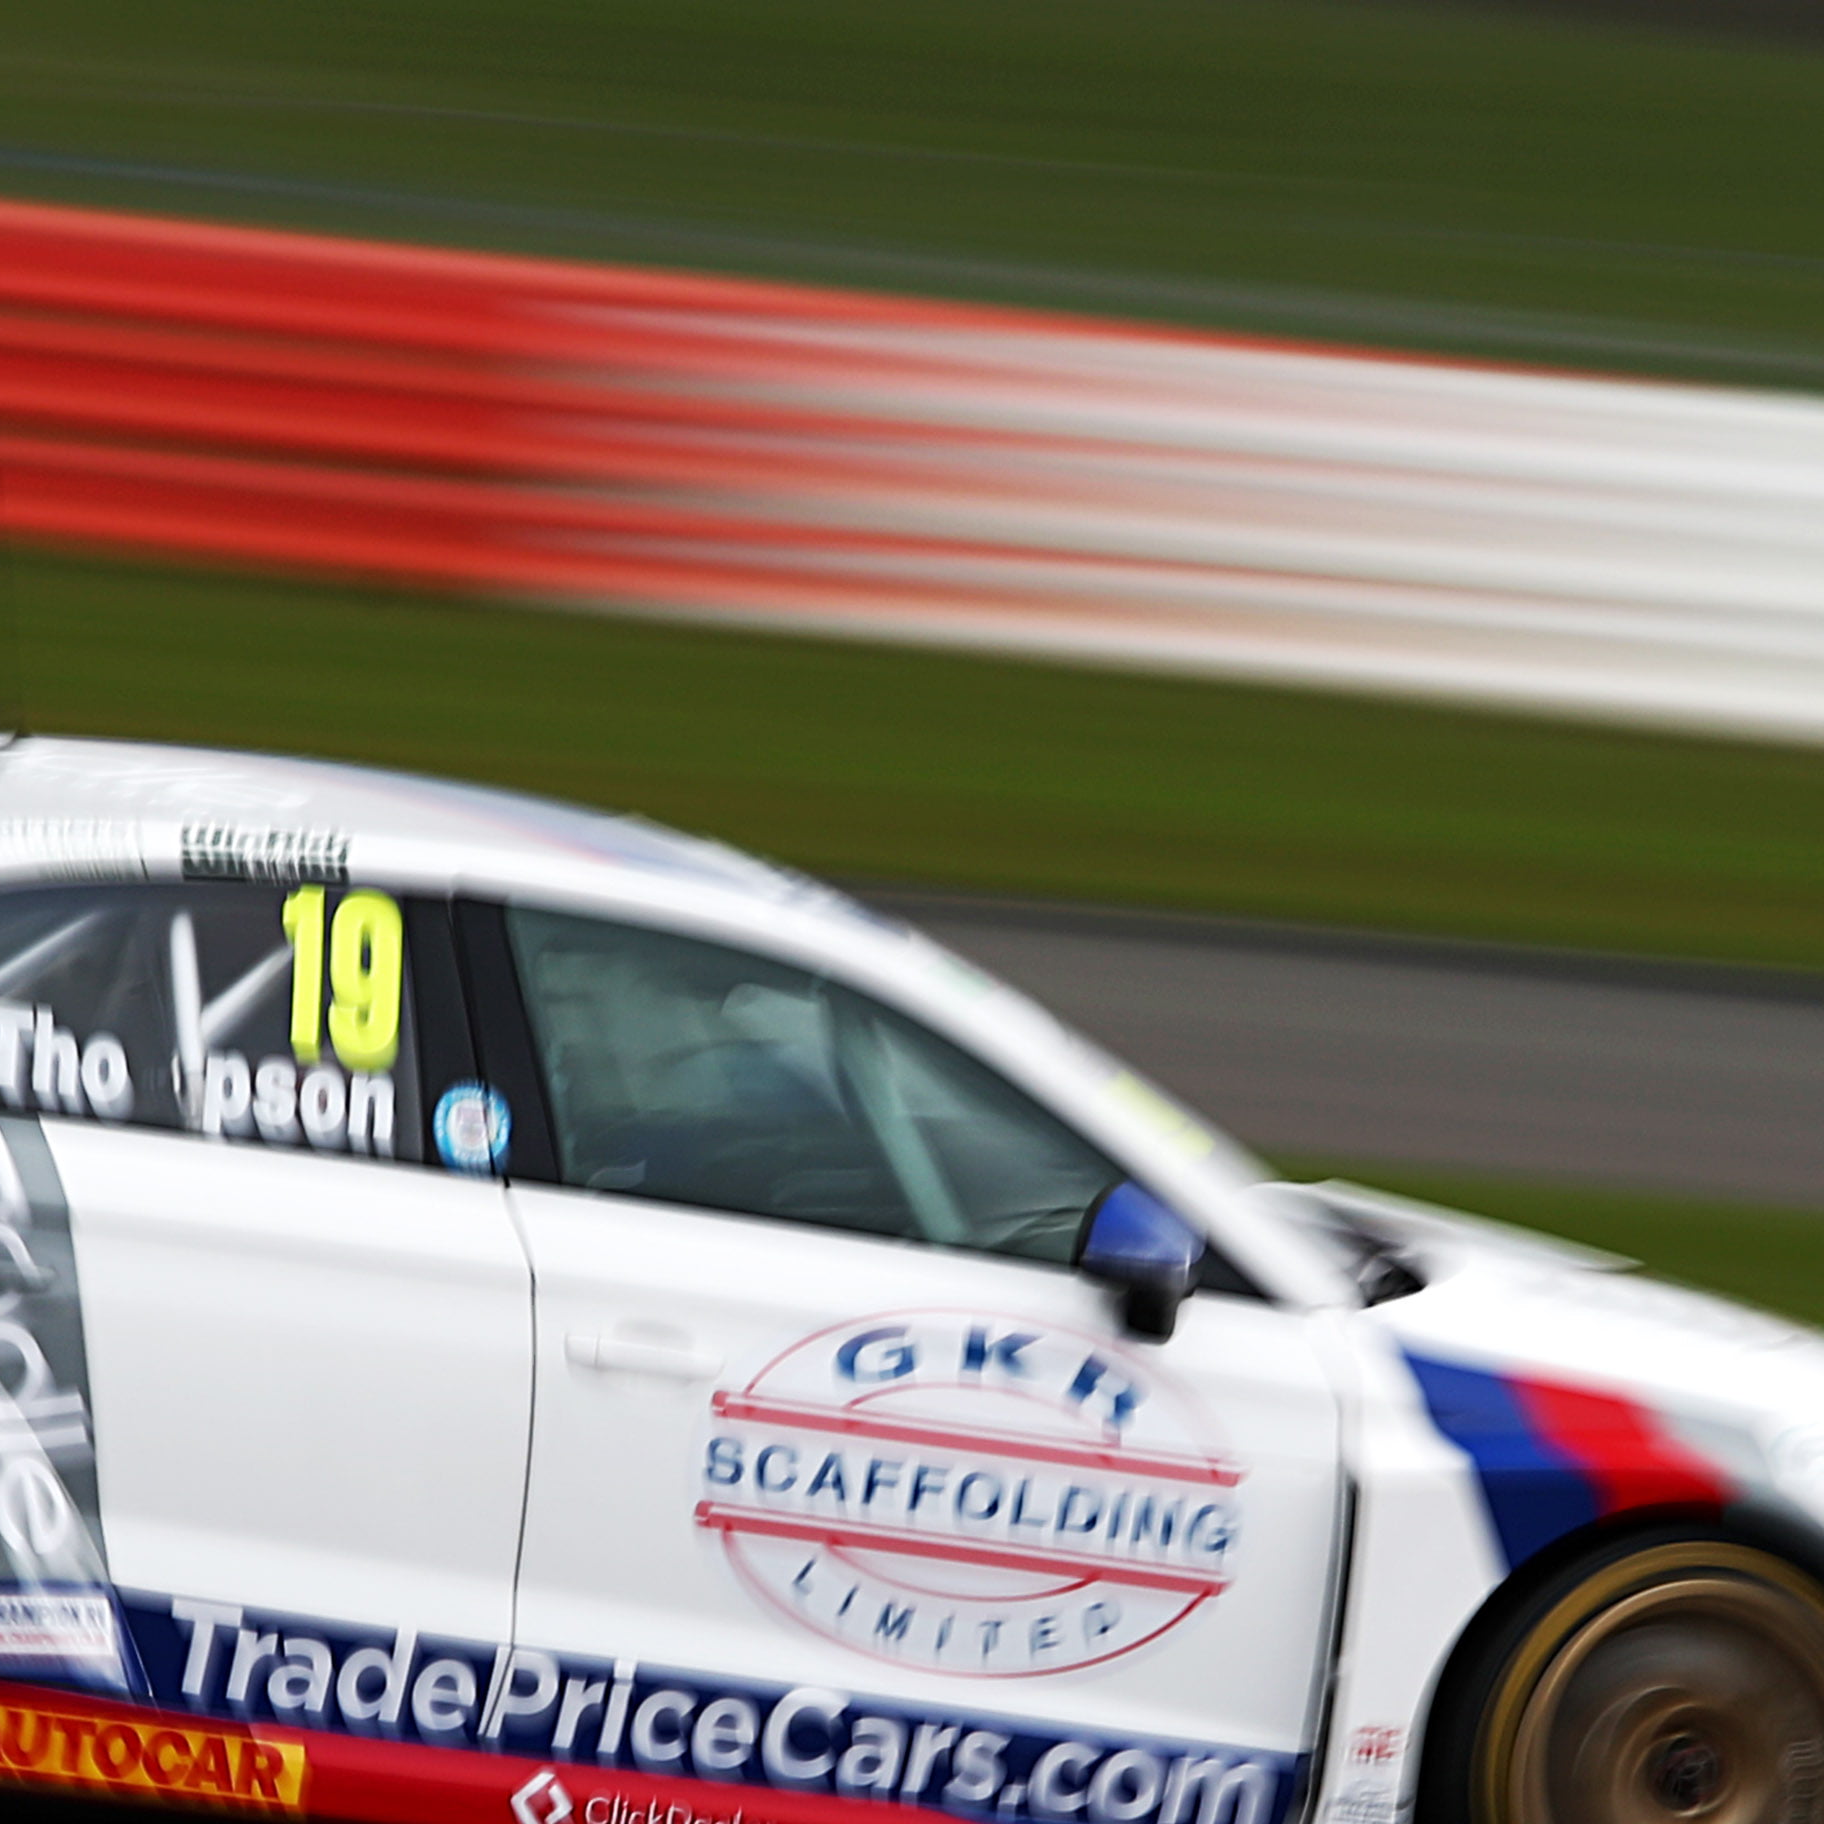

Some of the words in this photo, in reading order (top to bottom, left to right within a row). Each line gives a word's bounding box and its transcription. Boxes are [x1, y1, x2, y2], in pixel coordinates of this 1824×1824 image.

[281, 883, 404, 1072] 19
[704, 1437, 1239, 1554] SCAFFOLDING
[792, 1557, 1123, 1656] LIMITED
